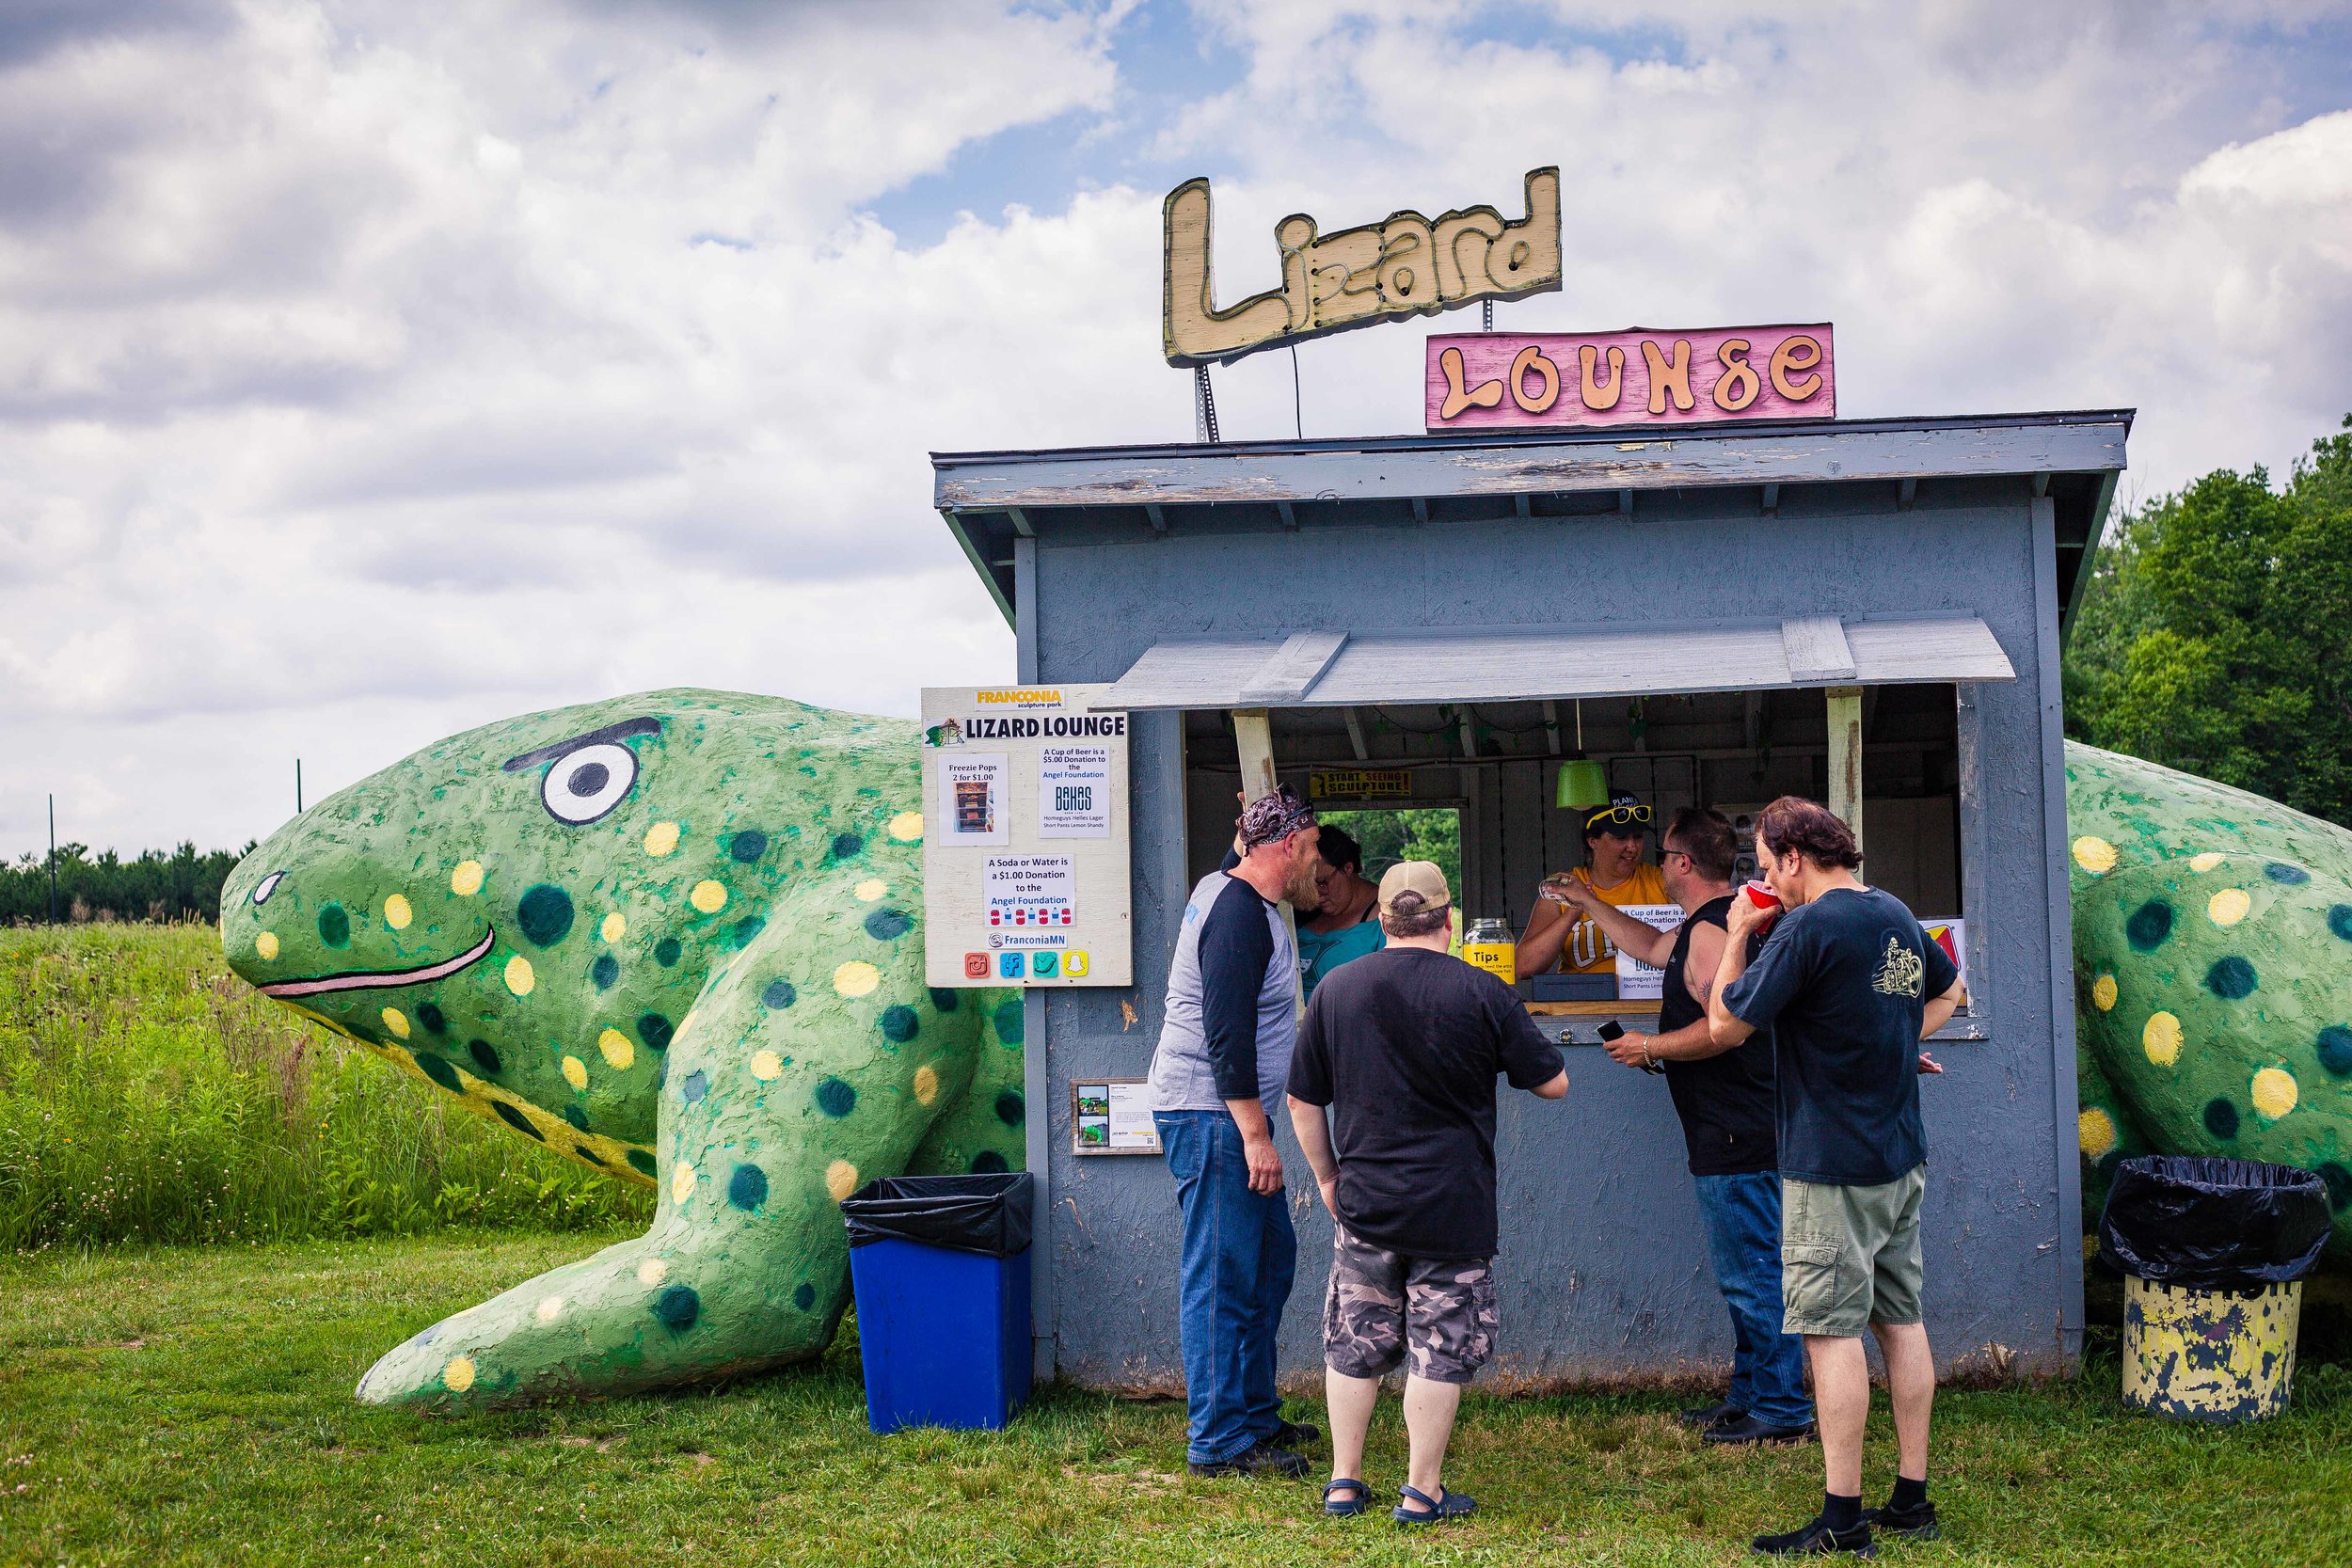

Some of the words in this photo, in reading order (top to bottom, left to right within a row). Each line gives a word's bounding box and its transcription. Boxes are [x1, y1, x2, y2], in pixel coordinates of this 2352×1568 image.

[1164, 166, 1563, 368] Lizard
[977, 689, 1062, 704] FRANCONIA
[966, 718, 1040, 738] LIZARD
[1043, 716, 1125, 736] LOUNGE
[1051, 749, 1065, 757] Cup
[972, 773, 993, 782] $1.00
[1328, 772, 1360, 782] START
[1365, 772, 1402, 782] SEEING
[996, 858, 1018, 866] Soda
[1061, 857, 1068, 865] is
[999, 871, 1024, 880] $1.00
[1025, 870, 1065, 879] Donation
[1026, 883, 1041, 892] the
[991, 896, 1016, 906] Angel
[1018, 895, 1067, 905] Foundation
[1005, 934, 1065, 944] FranconiaMN
[1473, 952, 1499, 964] Tips
